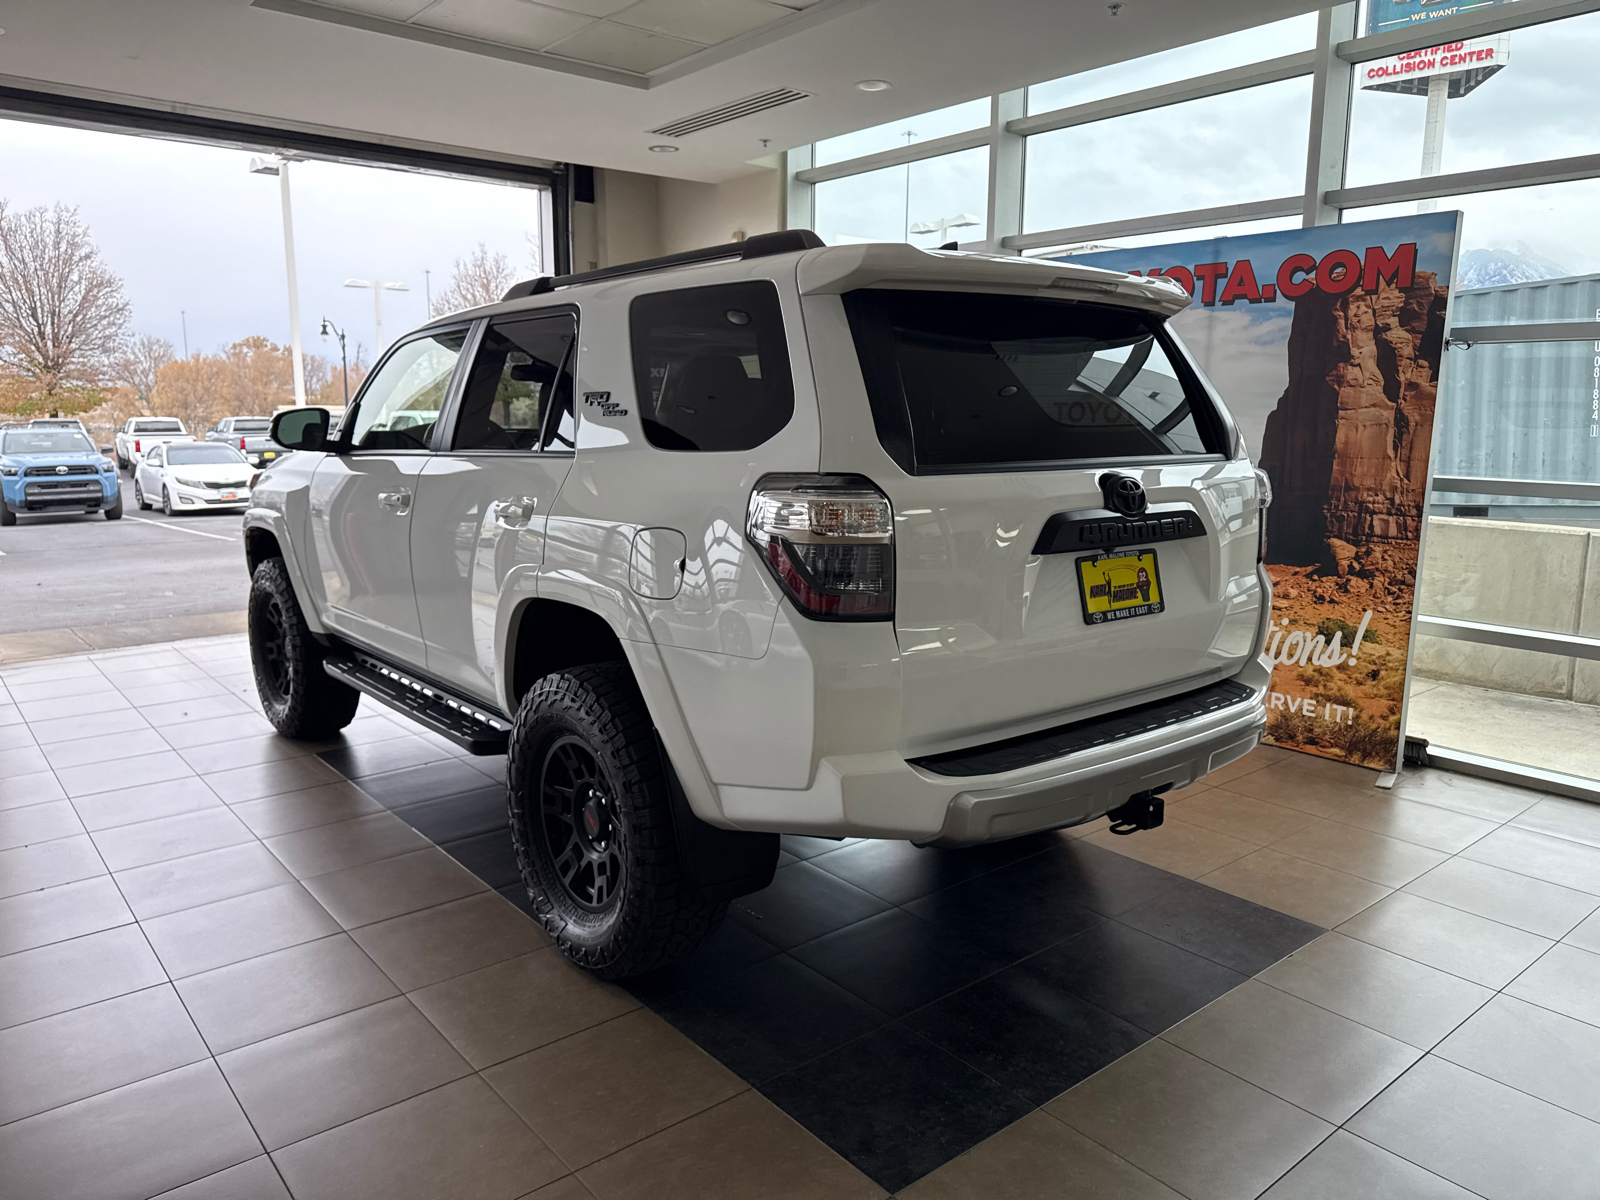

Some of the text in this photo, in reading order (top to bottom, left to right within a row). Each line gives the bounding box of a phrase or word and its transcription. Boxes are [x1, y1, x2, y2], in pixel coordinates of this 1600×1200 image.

[1411, 7, 1458, 21] WE WANT
[1367, 47, 1494, 79] COLLISION CENTER
[1127, 242, 1418, 306] OTA.COM
[583, 391, 611, 406] TRD
[1080, 517, 1187, 543] 4RUNNER
[1139, 572, 1147, 581] 32
[1090, 583, 1139, 603] KARL MALONE
[1106, 606, 1148, 620] WE MAKE IT EASY
[1266, 692, 1354, 725] RVE IT!
